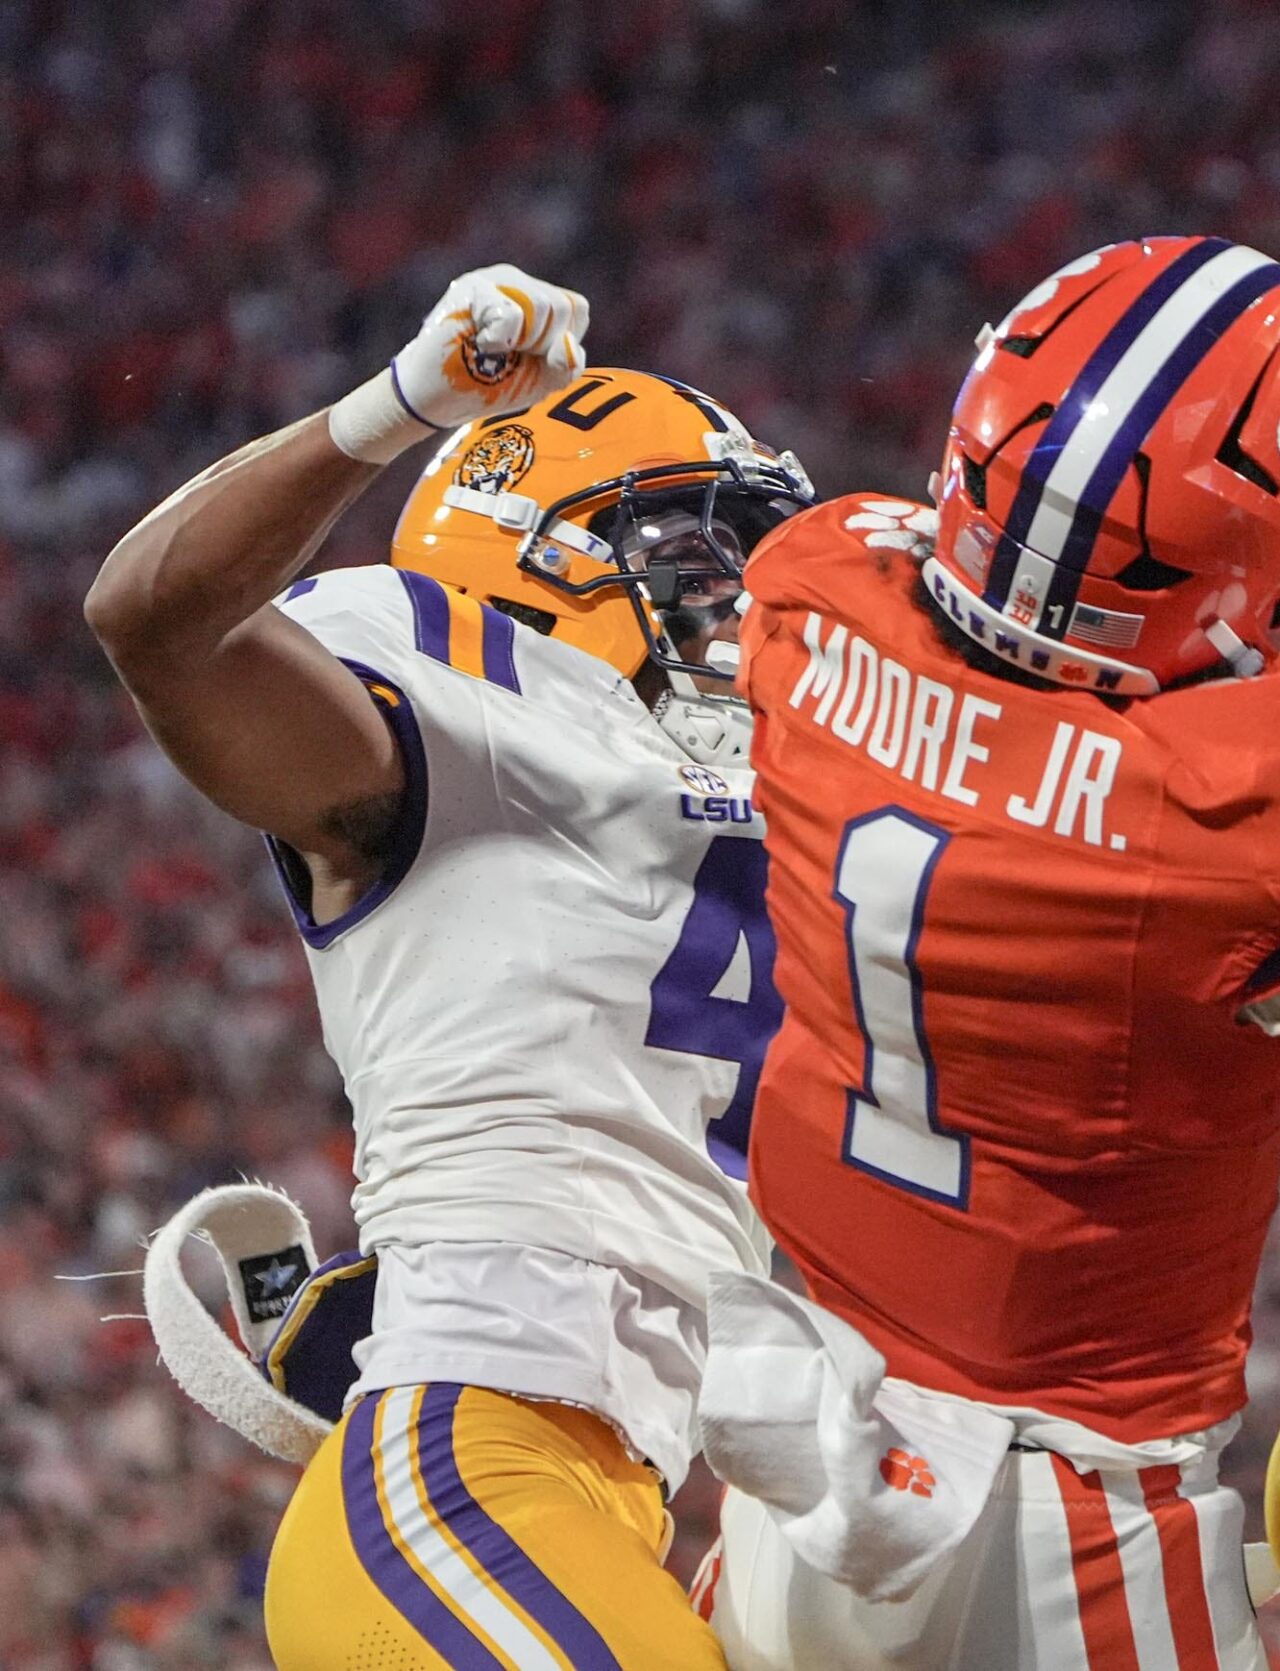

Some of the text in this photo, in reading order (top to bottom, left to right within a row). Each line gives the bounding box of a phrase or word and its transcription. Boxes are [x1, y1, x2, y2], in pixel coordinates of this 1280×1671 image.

[934, 574, 1123, 690] CLEMSN
[1048, 604, 1065, 629] 1
[680, 794, 752, 823] LSU
[788, 611, 1127, 852] MOORE JR.
[644, 835, 787, 1182] 4
[832, 803, 972, 1212] 1
